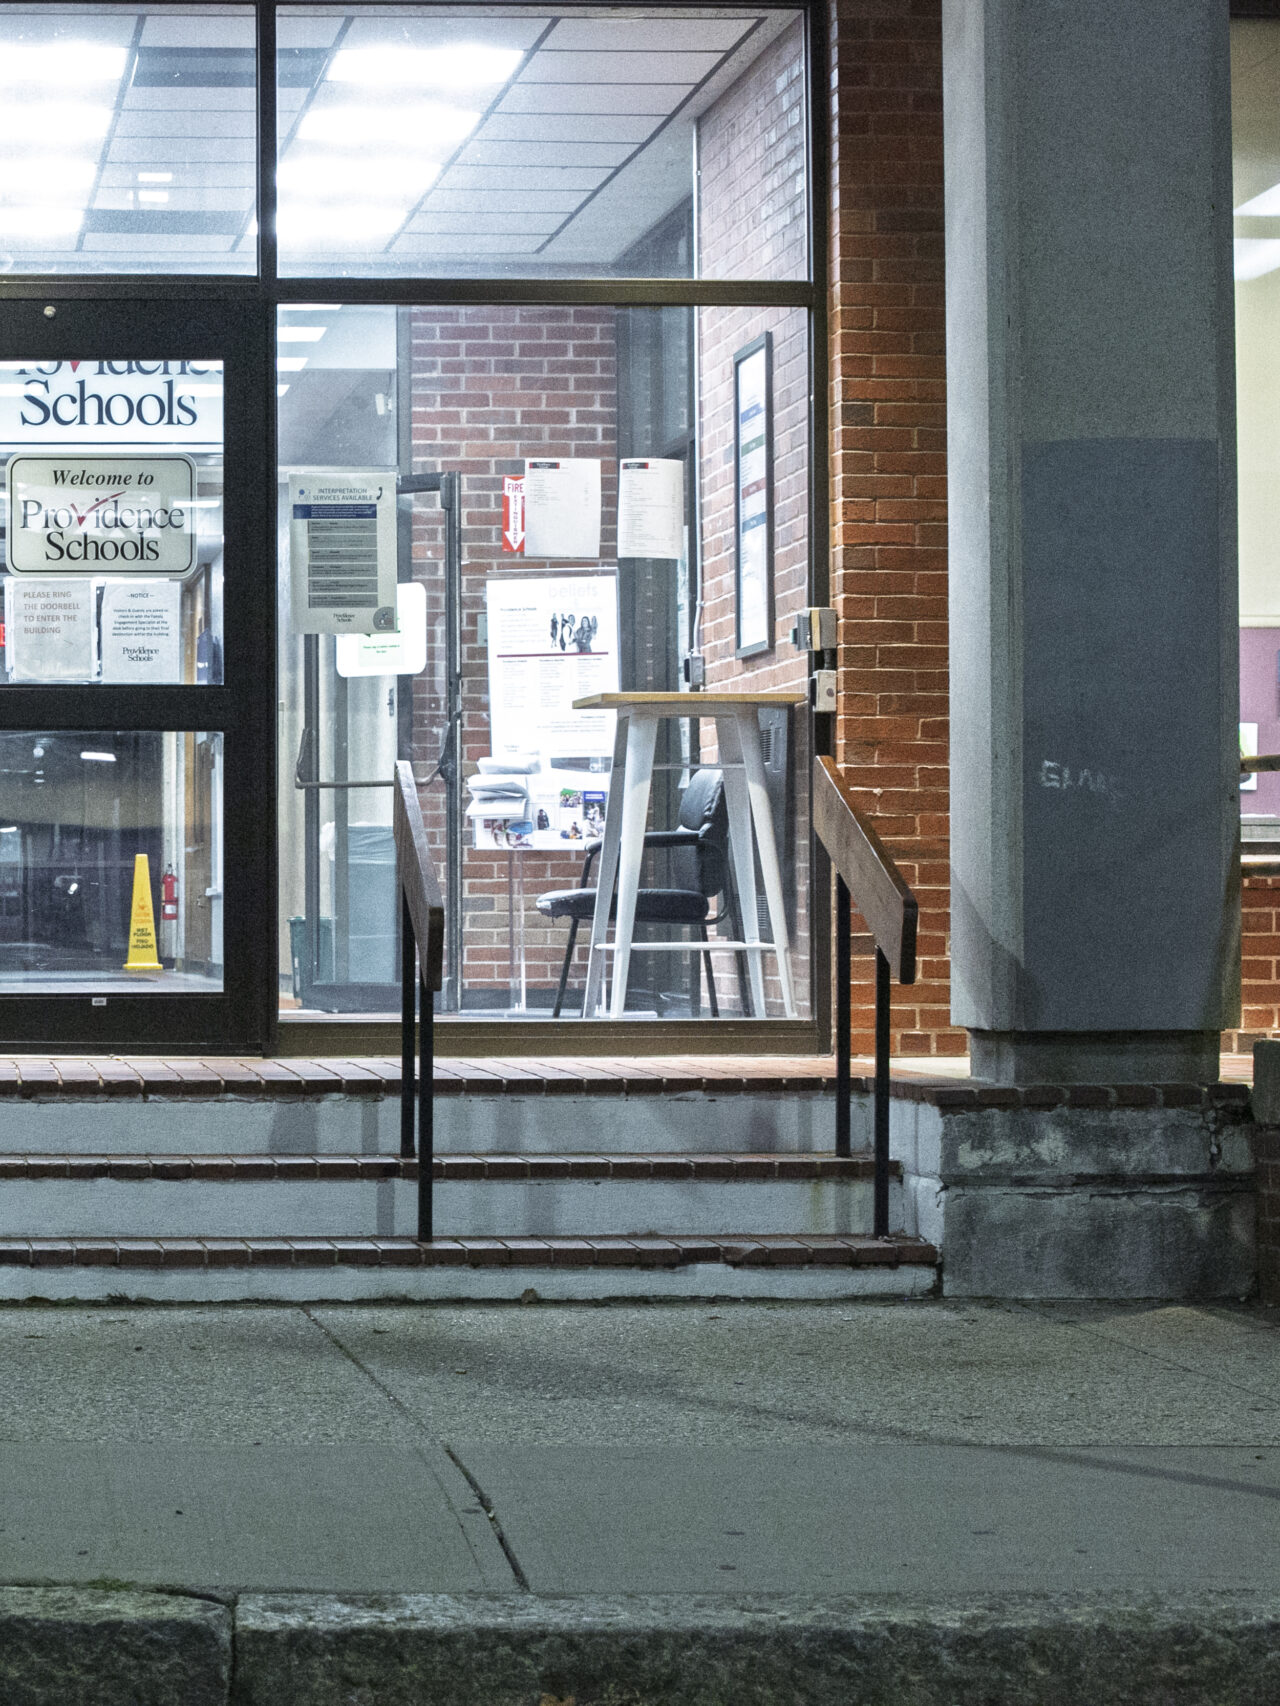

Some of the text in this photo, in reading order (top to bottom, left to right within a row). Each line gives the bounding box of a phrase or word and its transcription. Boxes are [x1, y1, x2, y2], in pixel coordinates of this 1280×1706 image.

[21, 379, 198, 426] Schools
[53, 469, 154, 486] Welcome to
[507, 483, 524, 493] FIRE
[20, 492, 185, 529] Providence
[45, 531, 160, 561] Schools
[23, 591, 51, 599] PLEASE
